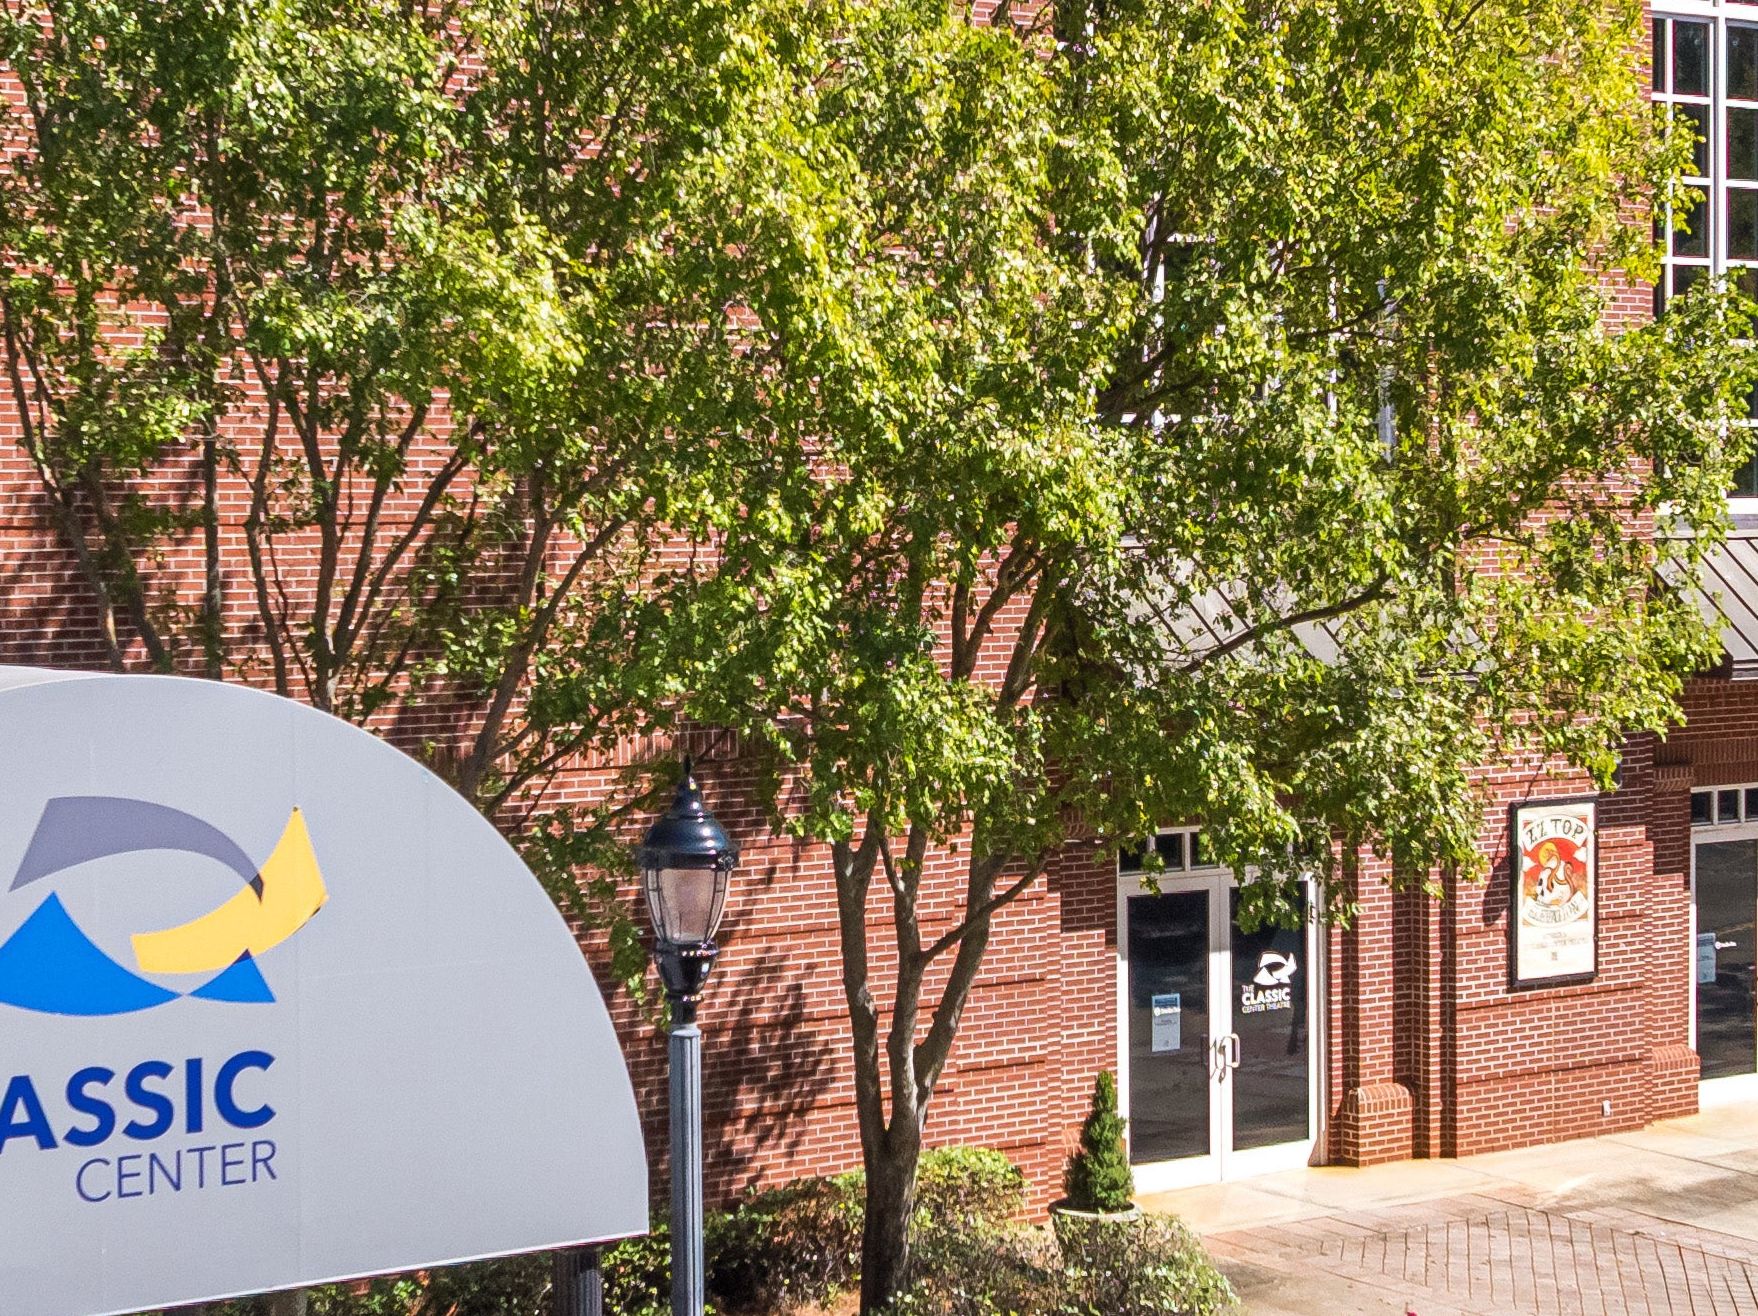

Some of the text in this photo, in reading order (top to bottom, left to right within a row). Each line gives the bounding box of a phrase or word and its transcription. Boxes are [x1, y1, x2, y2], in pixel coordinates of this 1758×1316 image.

[1550, 818, 1584, 839] TOP
[1241, 987, 1291, 1006] CLASSIC
[75, 1139, 278, 1204] CENTER
